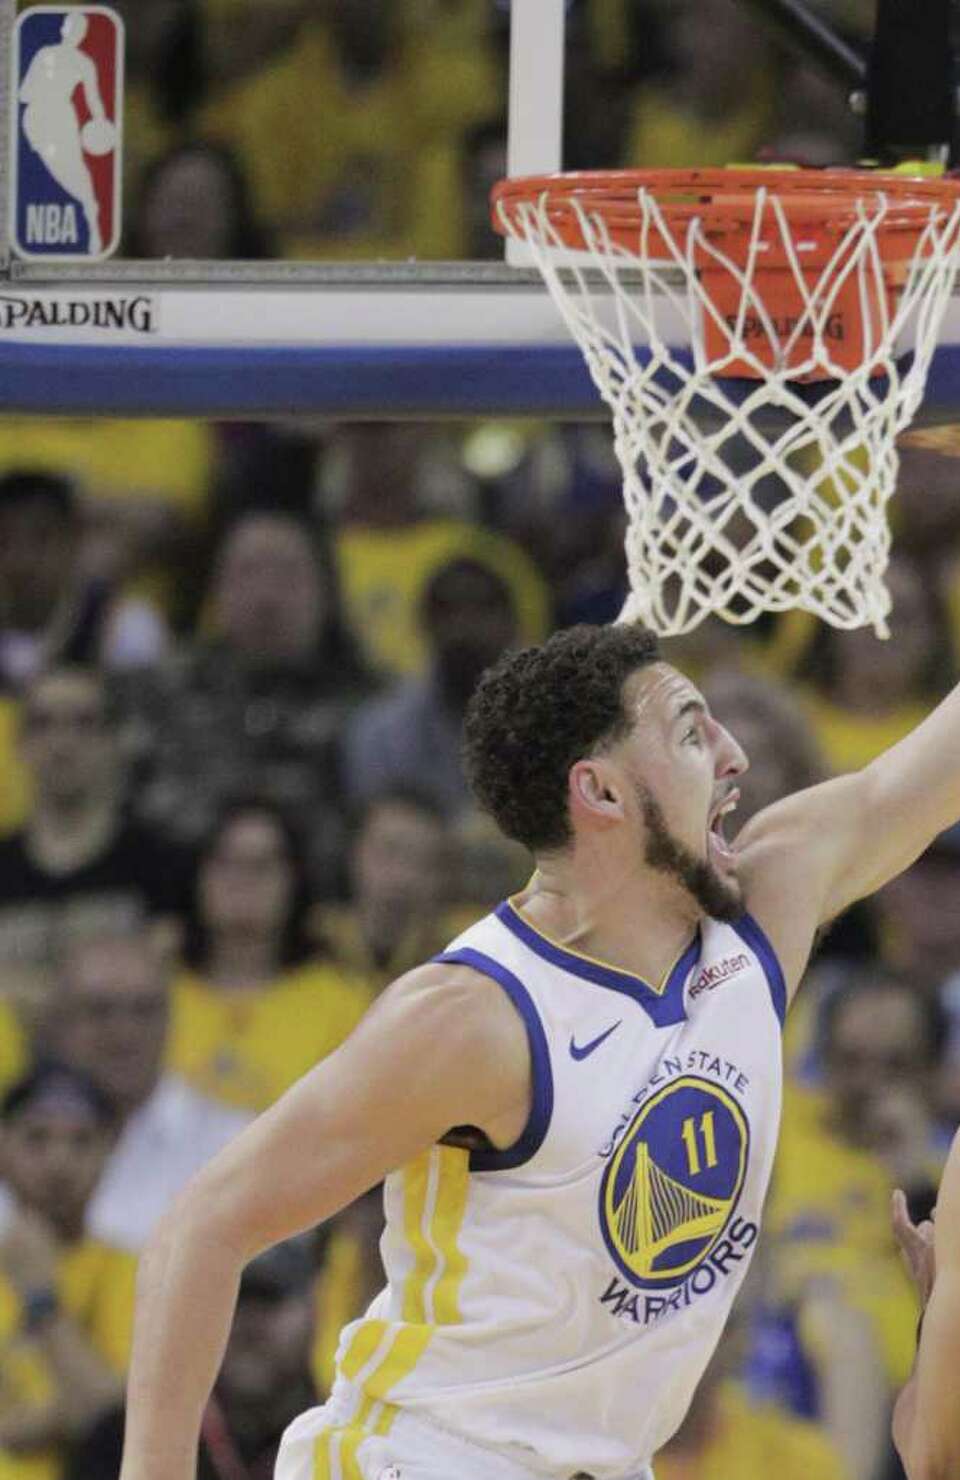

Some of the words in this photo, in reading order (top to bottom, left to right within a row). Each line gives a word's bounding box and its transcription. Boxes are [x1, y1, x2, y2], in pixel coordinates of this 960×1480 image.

[26, 203, 78, 244] NBA
[0, 296, 157, 333] PALDING
[687, 1050, 751, 1095] STATE
[681, 1110, 718, 1176] 11
[600, 1215, 758, 1325] WARRIORS
